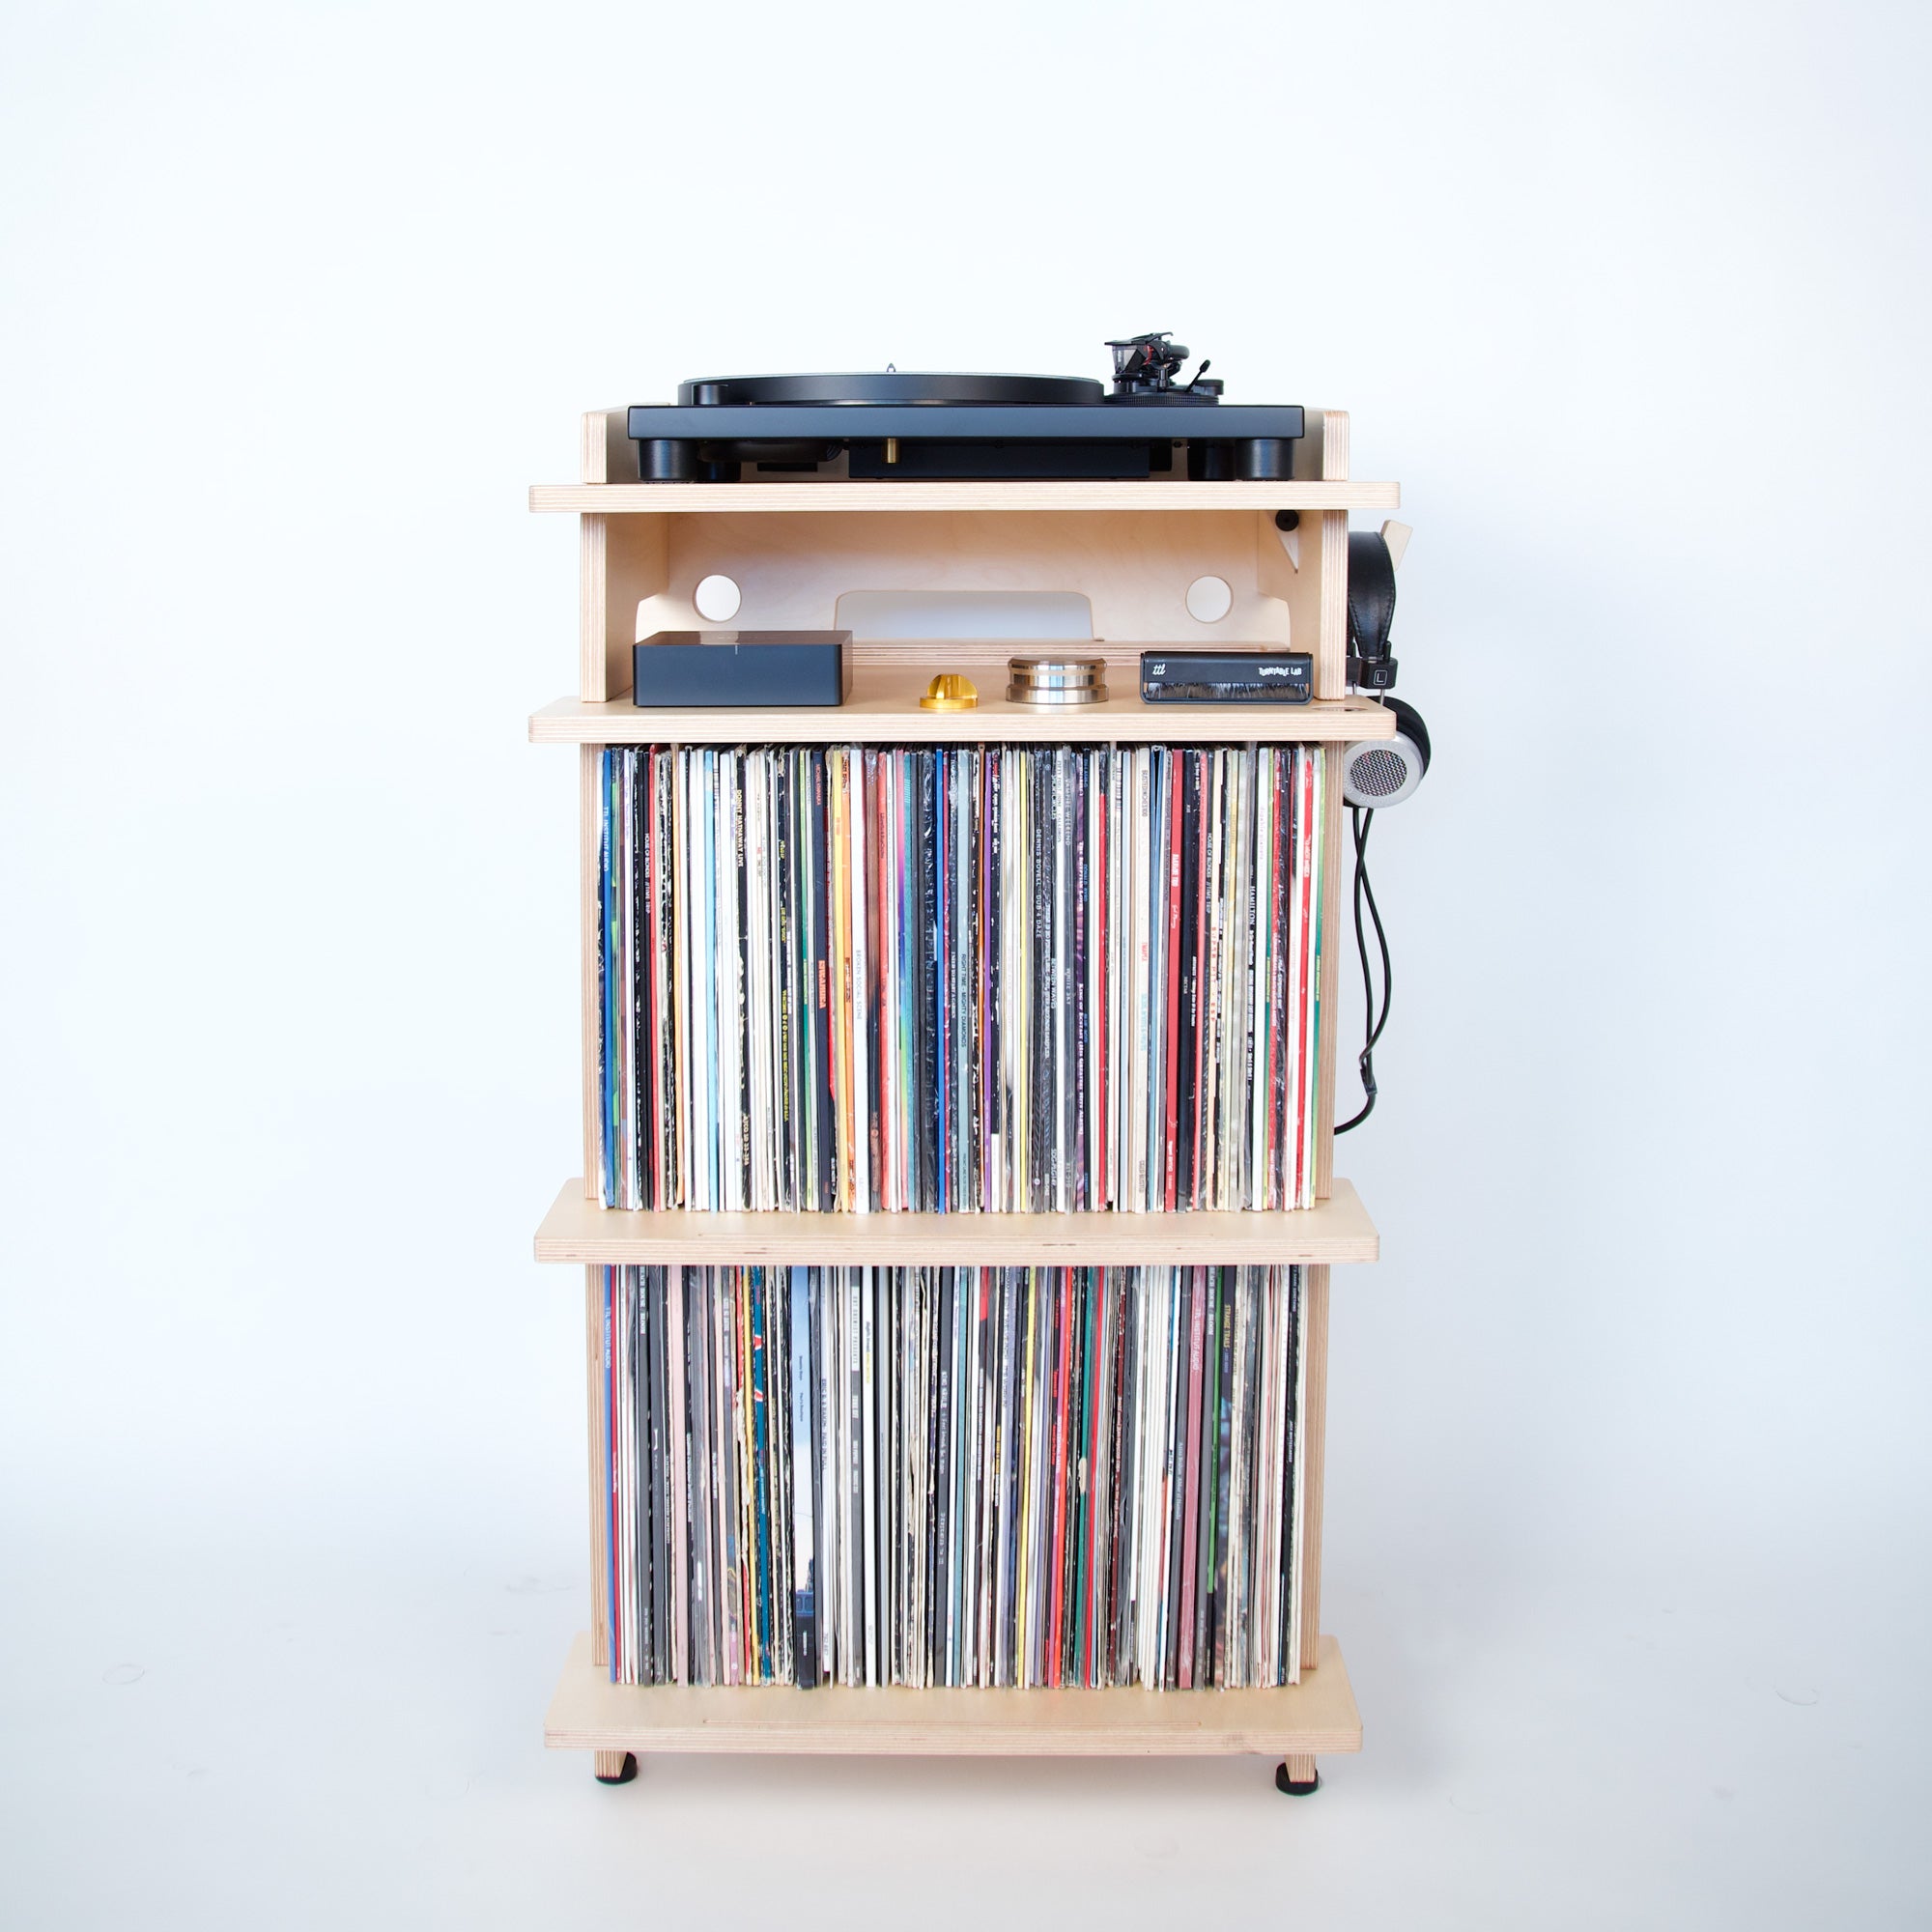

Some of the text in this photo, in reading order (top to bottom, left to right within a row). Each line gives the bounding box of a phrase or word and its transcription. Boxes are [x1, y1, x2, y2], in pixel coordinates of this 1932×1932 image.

[1152, 664, 1166, 675] ttl
[1259, 667, 1302, 676] TURNTABLE LAB
[1377, 673, 1383, 683] L
